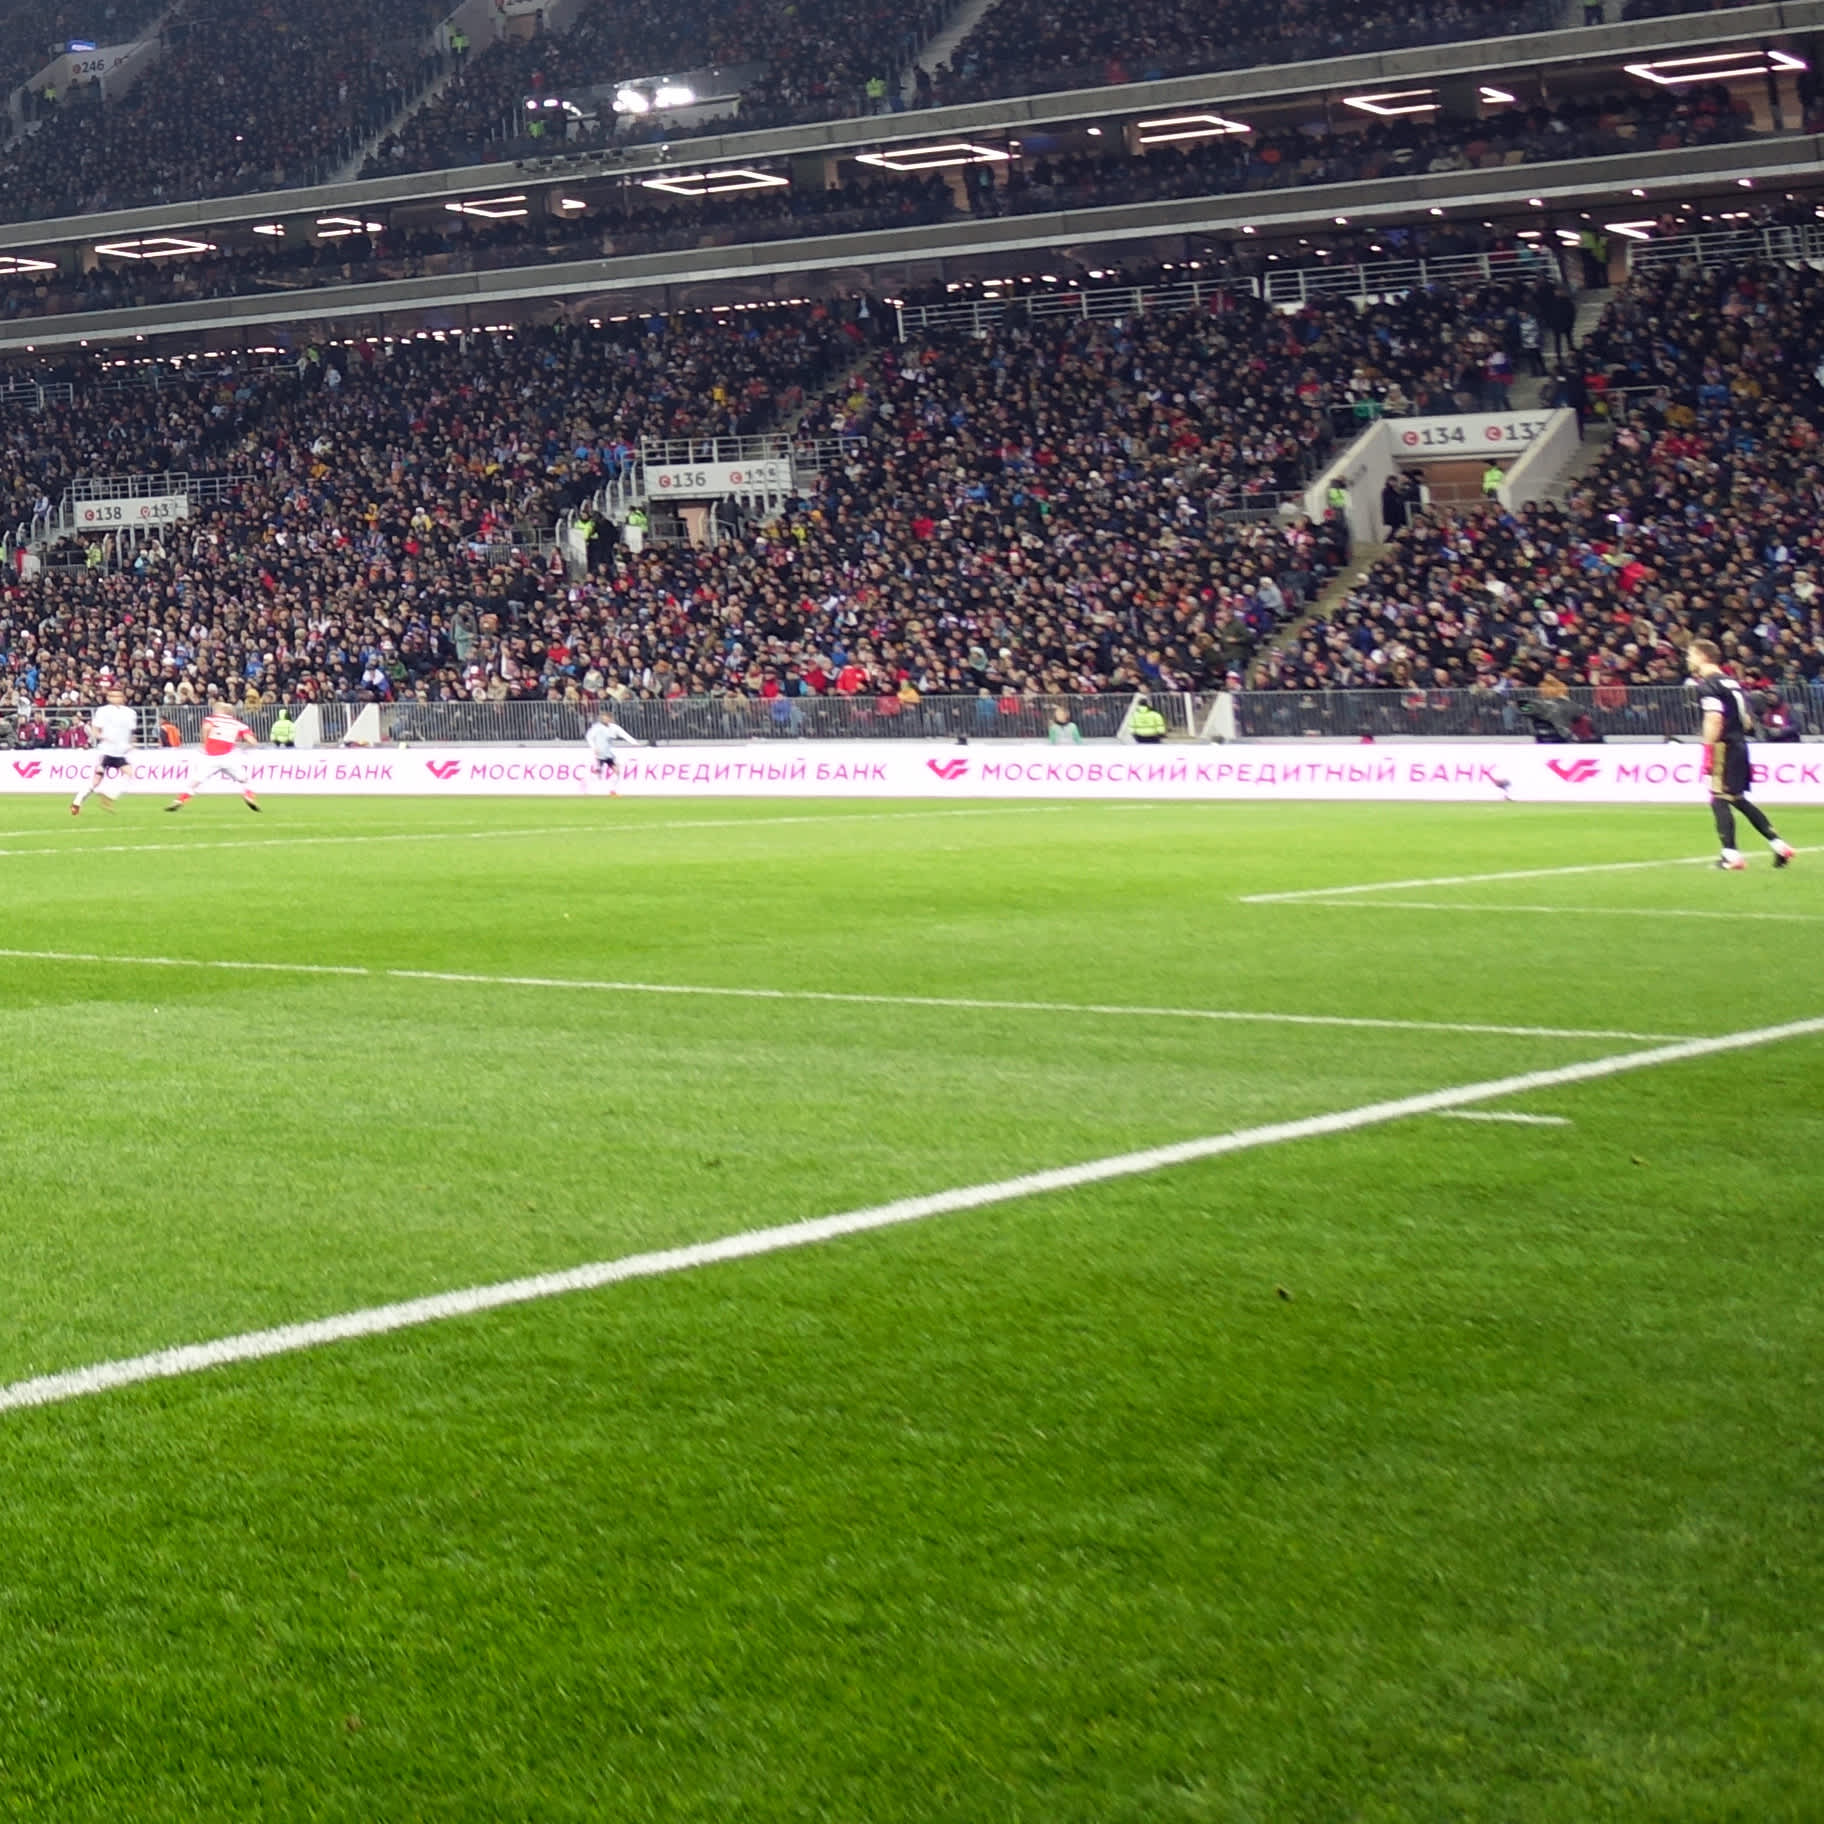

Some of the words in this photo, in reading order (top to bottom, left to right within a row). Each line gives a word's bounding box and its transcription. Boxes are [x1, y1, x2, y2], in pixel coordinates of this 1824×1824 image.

[81, 59, 105, 73] 246
[1421, 425, 1465, 445] 134
[673, 471, 706, 488] 136
[96, 506, 122, 521] 138
[335, 764, 394, 781] БАНК
[645, 757, 806, 783] КРЕДИТНЫЙ
[816, 760, 888, 781] БАНК
[982, 757, 1186, 782] МОСКОВСКИЙ
[1196, 757, 1396, 785] КРЕДИТНЫЙ
[1409, 762, 1498, 784] БАНК
